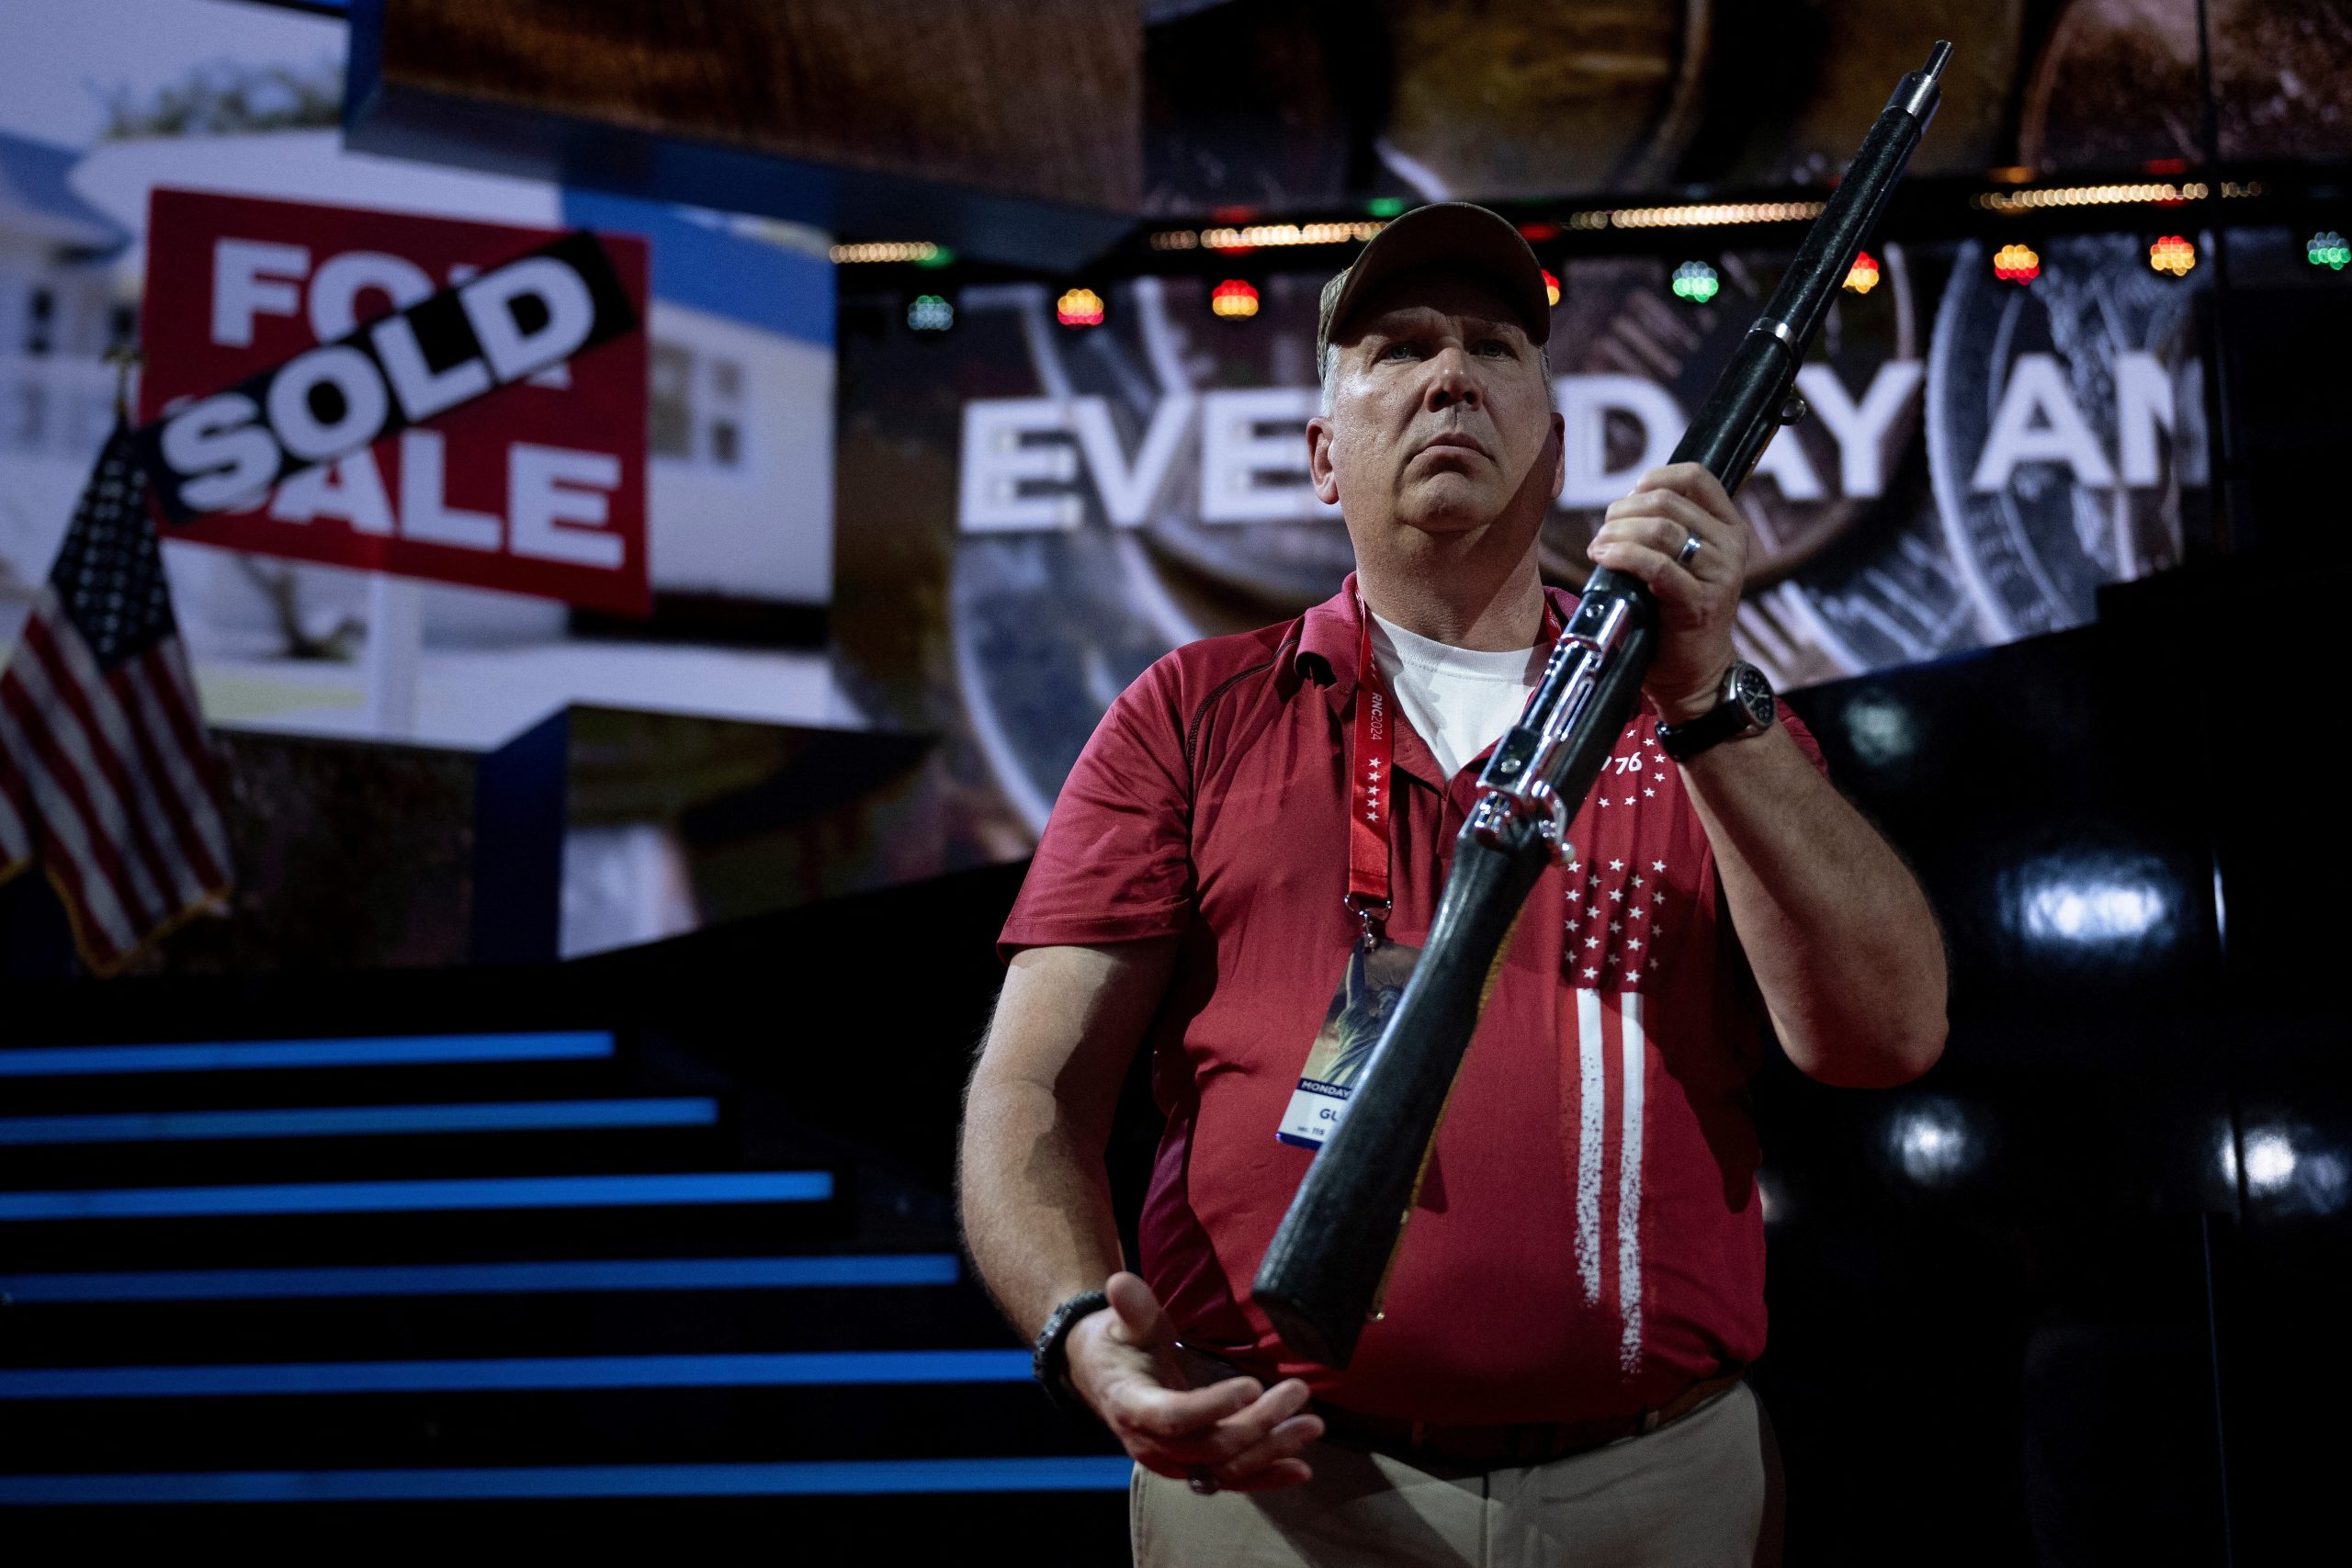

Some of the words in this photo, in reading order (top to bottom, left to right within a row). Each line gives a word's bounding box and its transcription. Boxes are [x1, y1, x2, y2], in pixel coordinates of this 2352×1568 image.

[209, 235, 574, 389] FO
[158, 254, 598, 514] SOLD
[1370, 692, 1383, 740] RNC2024
[1301, 1079, 1351, 1098] MONDAY
